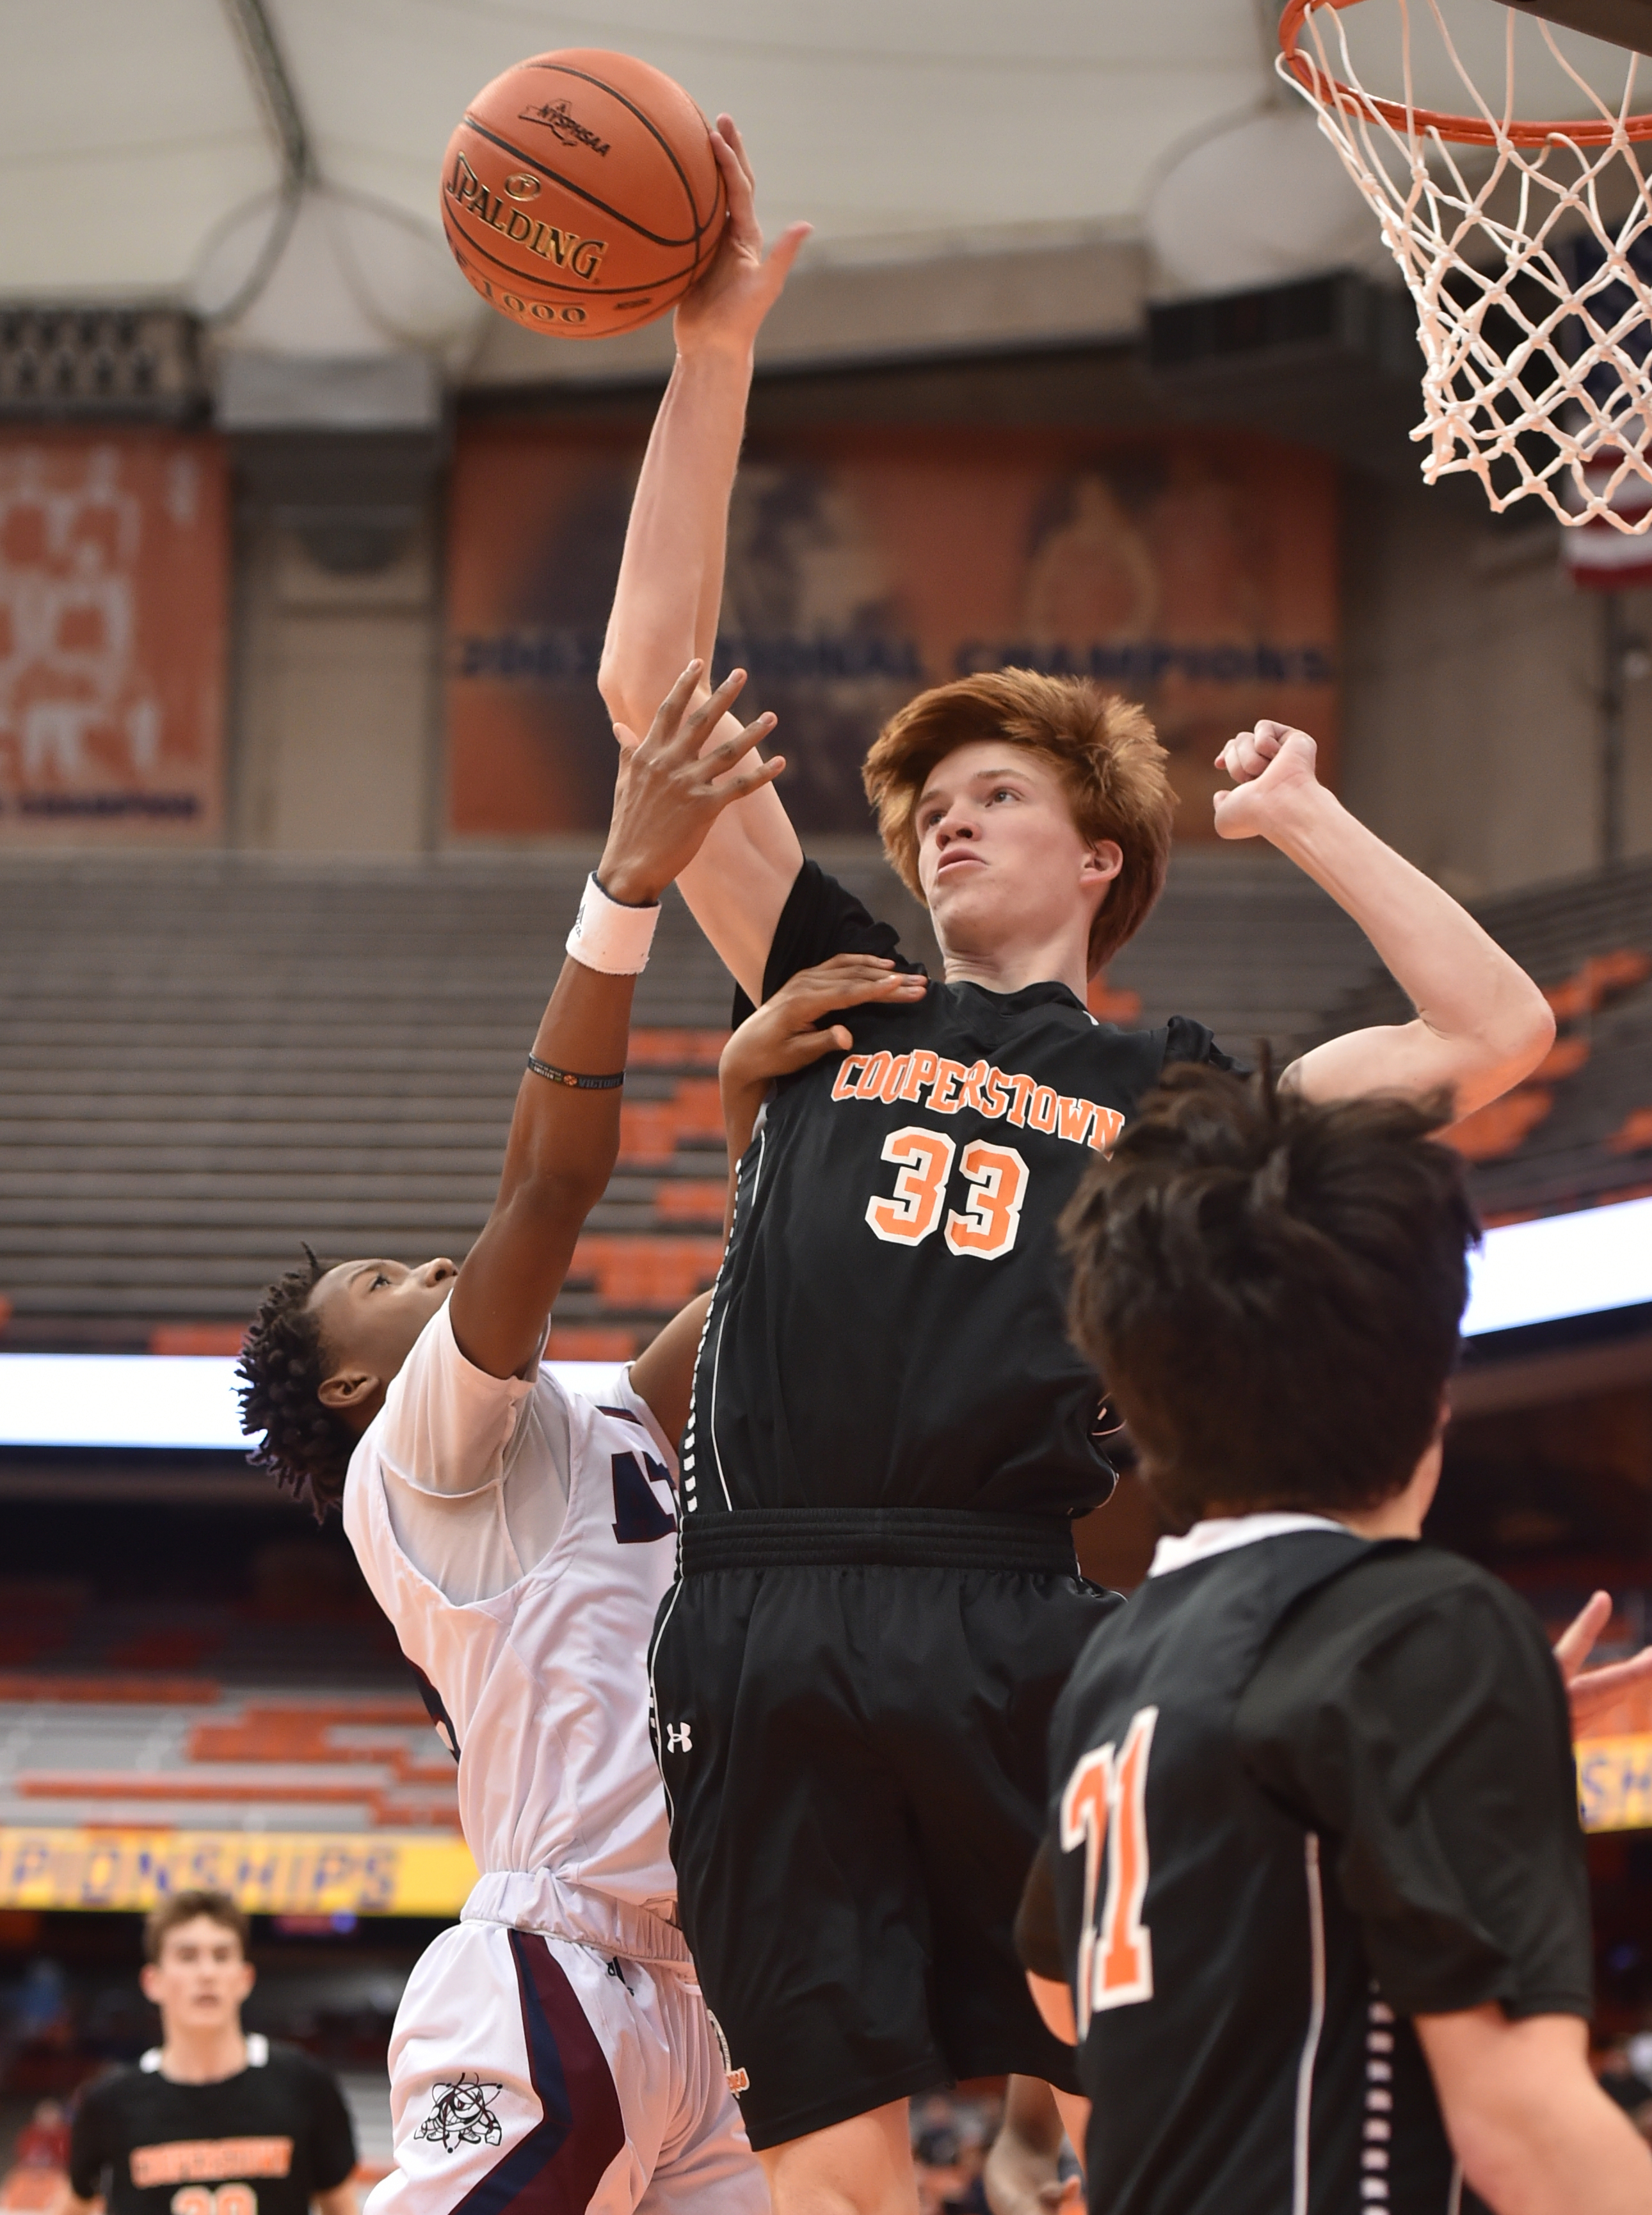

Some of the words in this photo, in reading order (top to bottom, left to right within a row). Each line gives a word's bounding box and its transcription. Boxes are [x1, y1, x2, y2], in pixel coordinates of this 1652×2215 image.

[445, 150, 609, 282] SPALDING
[831, 1048, 1126, 1163] COOPERSTOWN
[865, 1126, 1030, 1261] 33
